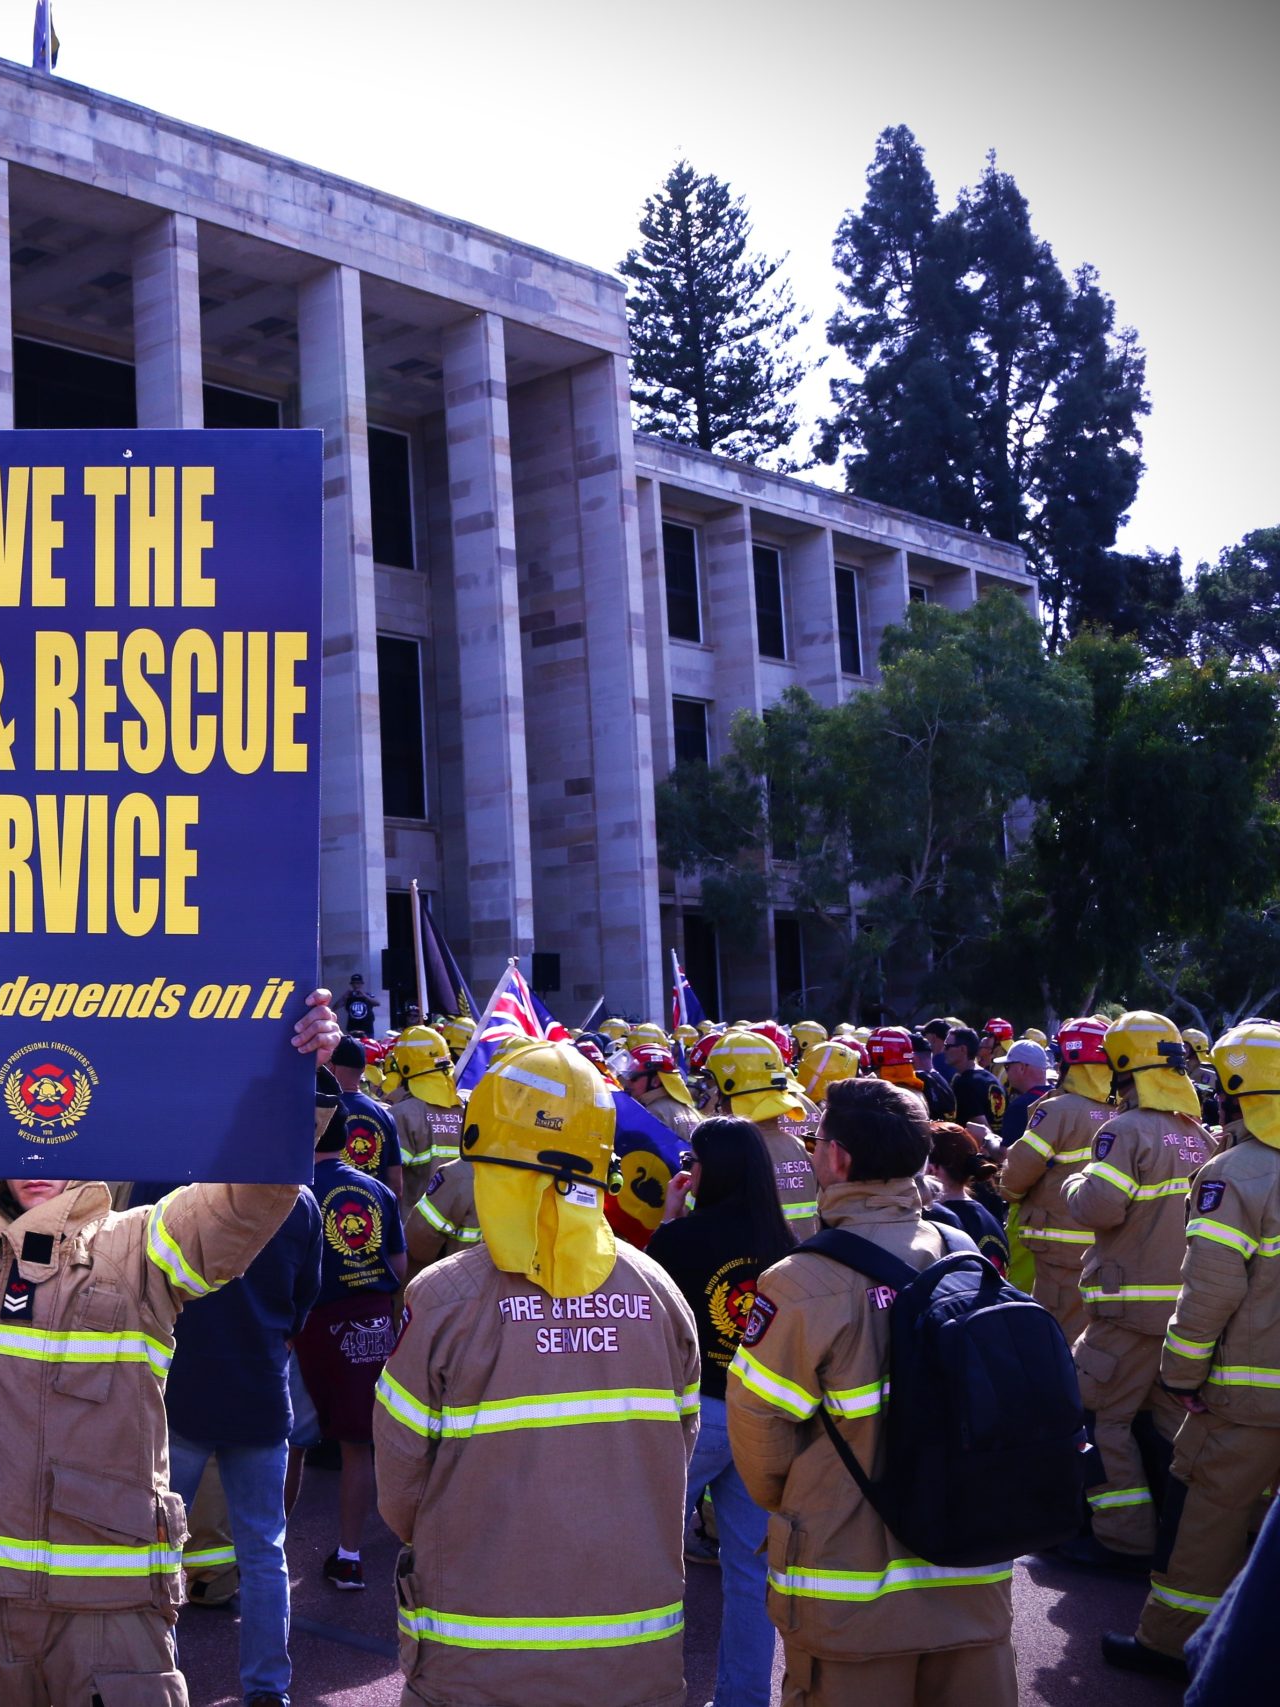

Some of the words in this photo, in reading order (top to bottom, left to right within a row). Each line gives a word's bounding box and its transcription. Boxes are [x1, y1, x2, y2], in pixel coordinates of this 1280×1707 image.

[84, 466, 216, 608] THE
[35, 628, 308, 775] RESCUE
[189, 984, 252, 1019] on
[252, 977, 295, 1020] it
[7, 1041, 50, 1065] PROFESSIONAL
[50, 1041, 91, 1067] FIREFIGHTERS
[86, 1065, 100, 1086] UNION
[17, 1128, 45, 1145] WESTERN
[46, 1130, 79, 1145] AUSTRALIA
[498, 1295, 544, 1323] FIRE
[552, 1298, 564, 1319] &
[566, 1293, 652, 1321] RESCUE
